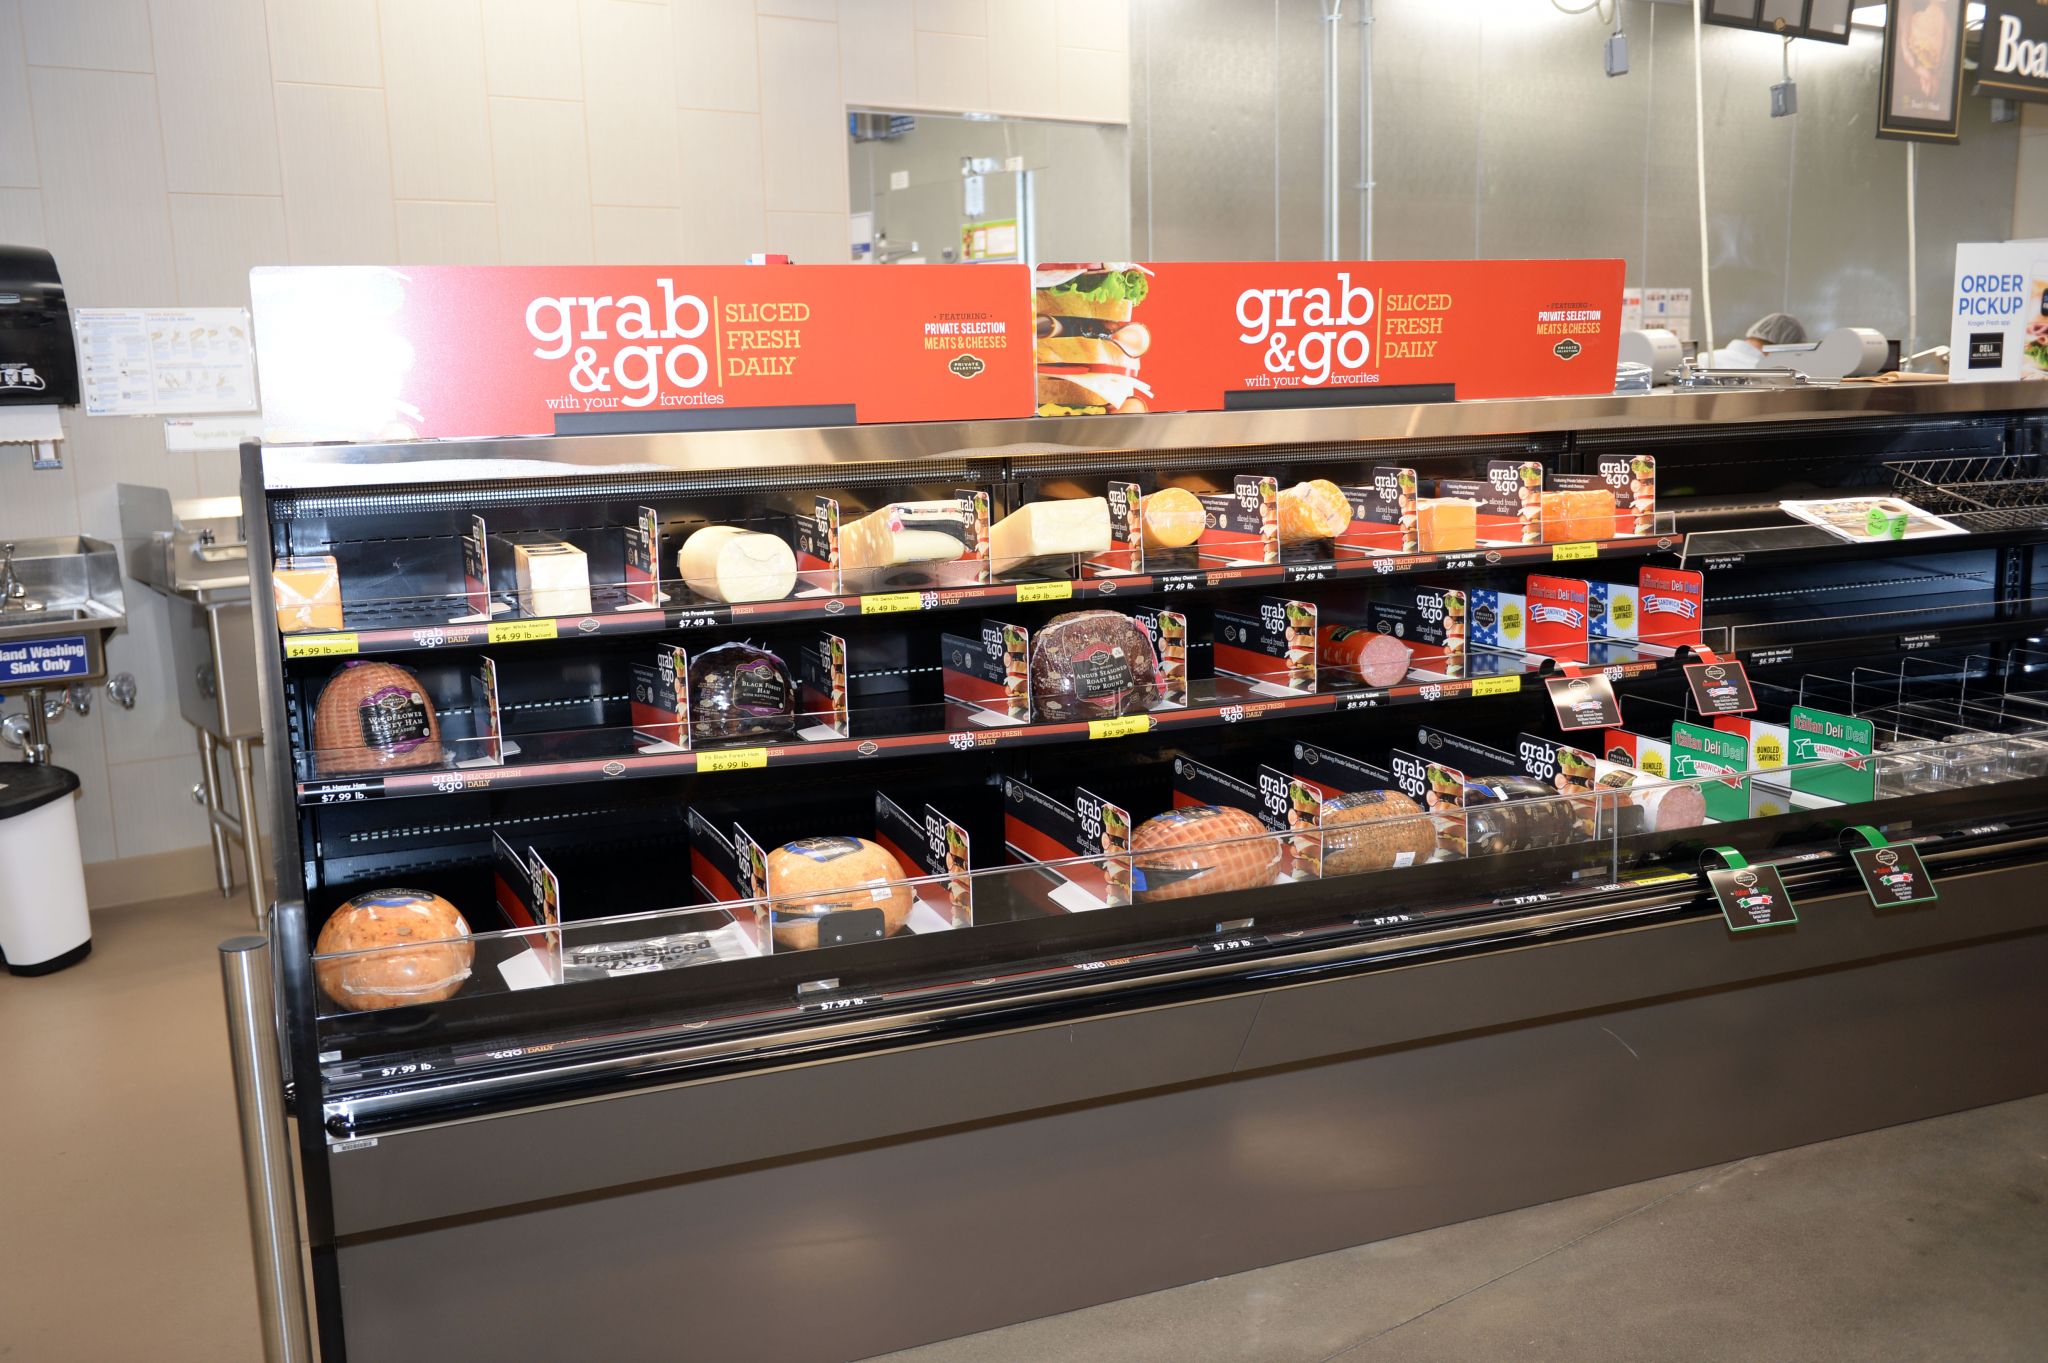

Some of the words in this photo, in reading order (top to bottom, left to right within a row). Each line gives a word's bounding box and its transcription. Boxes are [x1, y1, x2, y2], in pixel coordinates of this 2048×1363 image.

[1961, 274, 2023, 293] ORDER
[1236, 272, 1374, 345] grab
[1386, 294, 1452, 311] SLICED
[1959, 297, 2023, 315] PICKUP
[526, 278, 709, 359] grab
[725, 302, 810, 324] SLICED
[1538, 311, 1566, 322] PRIVATE
[1566, 310, 1601, 321] SELECTION
[924, 322, 960, 335] PRIVATE
[960, 322, 1006, 334] SELECTION
[1386, 317, 1442, 335] FRESH
[1536, 324, 1562, 335] MEATS
[1568, 322, 1600, 334] CHEESES
[727, 330, 801, 351] FRESH
[924, 336, 956, 350] MEATS
[958, 336, 965, 349] &
[966, 335, 1007, 349] CHEESES
[1979, 344, 1993, 352] DELI
[1264, 330, 1370, 385] &go
[1384, 341, 1437, 360] DAILY
[728, 355, 797, 377] DAILY
[568, 344, 709, 407] &go
[1244, 373, 1270, 386] with
[1272, 376, 1300, 389] your
[1330, 371, 1379, 384] favorites
[546, 394, 580, 409] with
[583, 394, 618, 411] your
[660, 391, 724, 406] favorites
[1490, 466, 1518, 485] grab
[1600, 460, 1630, 477] grab
[1375, 473, 1397, 490] grab
[1496, 480, 1518, 496] &go
[1606, 474, 1629, 488] &go
[1108, 488, 1127, 504] grab
[1236, 482, 1258, 500] grab
[1380, 488, 1397, 503] &go
[1241, 496, 1259, 512] &go
[1373, 558, 1393, 568] grab
[1295, 573, 1315, 581] $7.49
[1164, 584, 1184, 592] $7.49
[1187, 582, 1196, 590] lb.
[1671, 580, 1684, 591] Deli
[920, 591, 938, 601] rab
[1417, 593, 1443, 610] grab
[1558, 589, 1570, 600] Deli
[1261, 603, 1285, 620] grab
[1613, 605, 1631, 613] BUNDLED
[1658, 600, 1680, 608] SANDWICH
[679, 619, 704, 628] $7.49
[707, 617, 718, 626] lb.
[1422, 607, 1442, 624] &go
[1614, 612, 1632, 620] SAVINGS!
[1266, 618, 1284, 635] &go
[1504, 621, 1520, 630] SAVINGS!
[413, 628, 443, 641] grab
[496, 633, 520, 642] $4.99
[982, 627, 1002, 645] grab
[30, 644, 84, 658] Washing
[292, 647, 319, 657] $4.99
[987, 642, 1002, 660] &go
[10, 661, 40, 674] Sink
[42, 658, 71, 672] Only
[658, 651, 674, 670] grab
[1076, 671, 1098, 680] ANGUS
[1100, 665, 1127, 676] SEASONED
[1603, 666, 1622, 674] grab
[765, 683, 781, 692] FOREST
[1087, 677, 1106, 685] ROAST
[1103, 680, 1124, 688] ROUND
[1420, 684, 1441, 696] grab
[1220, 705, 1242, 717] grab
[1347, 702, 1367, 710] $5.99
[949, 731, 974, 744] grab
[977, 732, 1001, 740] SLICED
[1002, 730, 1023, 738] FRESH
[1794, 715, 1823, 735] Italian
[1826, 722, 1843, 739] Deli
[1846, 726, 1868, 745] Deal
[1520, 742, 1555, 764] grab
[1675, 731, 1702, 750] Italian
[1705, 739, 1720, 755] Deli
[1723, 743, 1744, 762] Deal
[1757, 746, 1779, 754] BUNDLED
[1815, 745, 1843, 756] SANDWICH
[1758, 754, 1780, 762] SAVINGS!
[712, 762, 738, 771] $6.99
[1393, 758, 1425, 780] grab
[1526, 758, 1553, 780] &go
[1695, 762, 1721, 774] SANDWICH
[432, 773, 463, 787] grab
[1260, 774, 1288, 799] grab
[1399, 775, 1424, 797] &go
[322, 793, 351, 803] $7.99
[355, 791, 368, 800] lb.
[1265, 792, 1286, 816] &go
[1077, 797, 1101, 822] grab
[926, 815, 945, 841] grab
[1082, 815, 1100, 840] &go
[1515, 896, 1537, 904] $7.99
[1374, 916, 1398, 925] $7.99
[1213, 942, 1239, 951] $7.99
[821, 1000, 850, 1010] $7.99
[382, 1065, 417, 1077] $7.99
[421, 1063, 436, 1072] lb.
